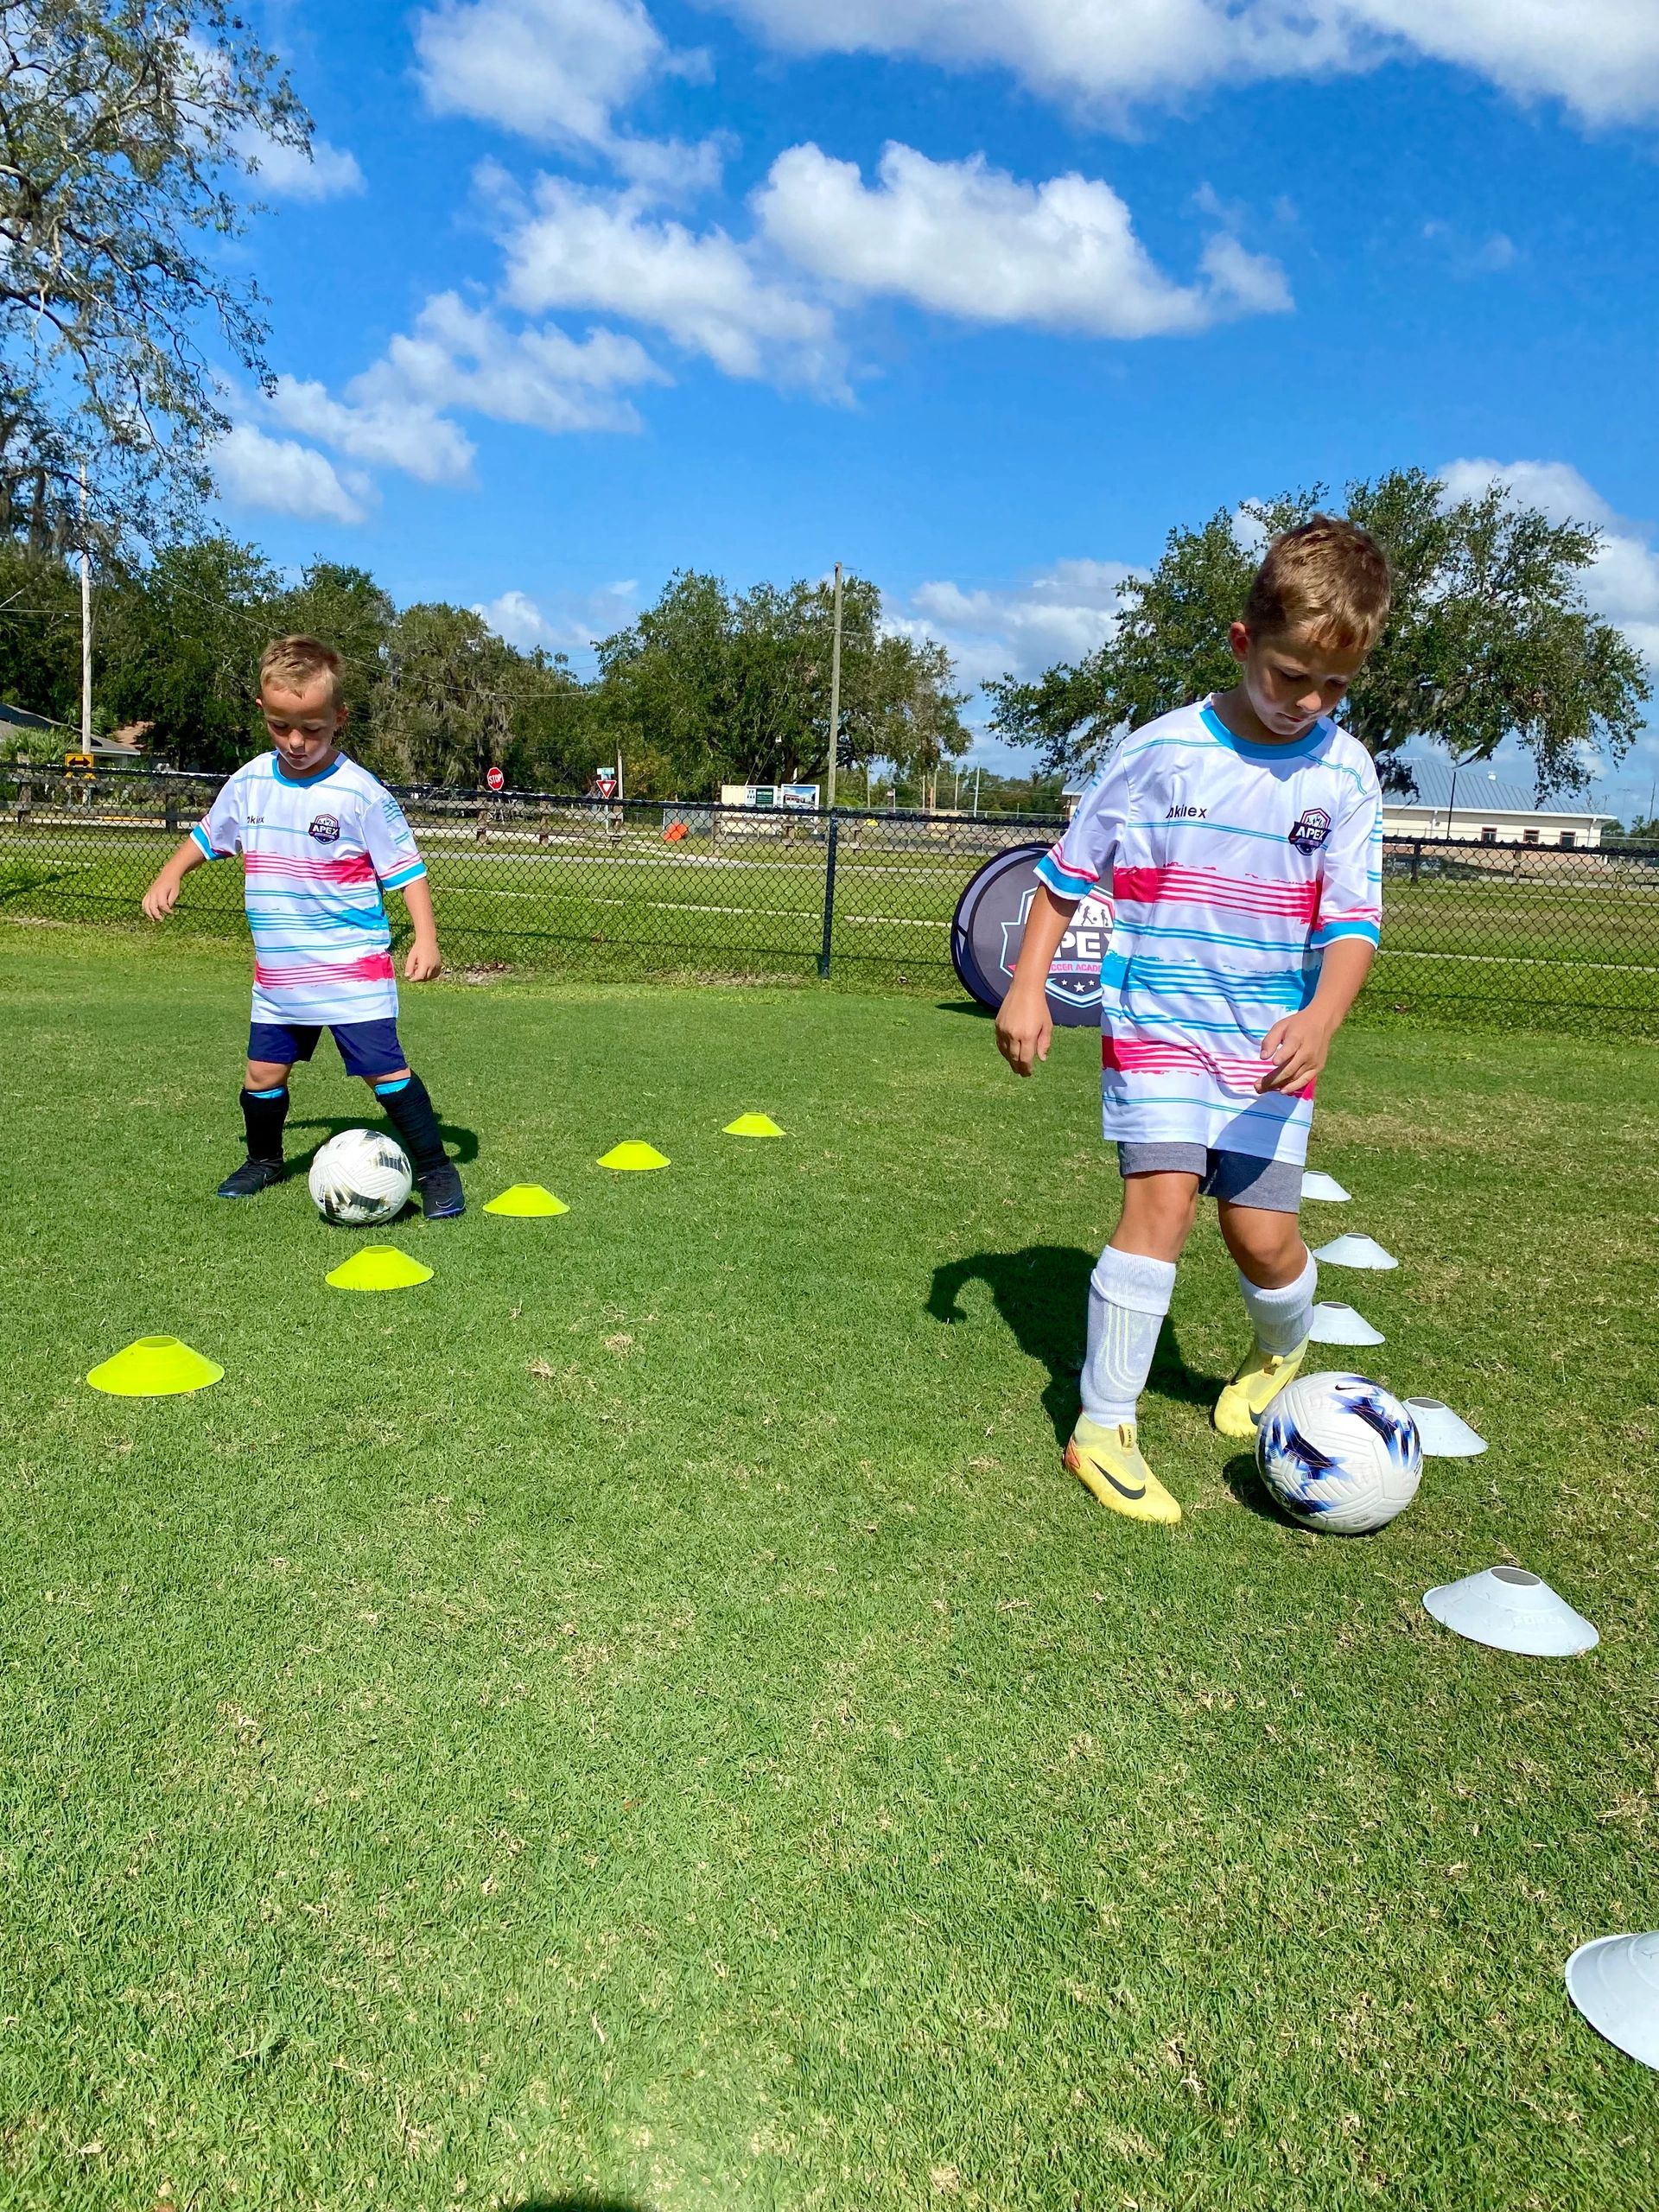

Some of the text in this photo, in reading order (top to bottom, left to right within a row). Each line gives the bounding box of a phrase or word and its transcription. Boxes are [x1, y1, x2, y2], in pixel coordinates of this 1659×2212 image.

[488, 773, 502, 784] STOP
[313, 825, 338, 836] APEX
[1053, 931, 1112, 959] PE
[1050, 963, 1101, 972] CCER ACAD
